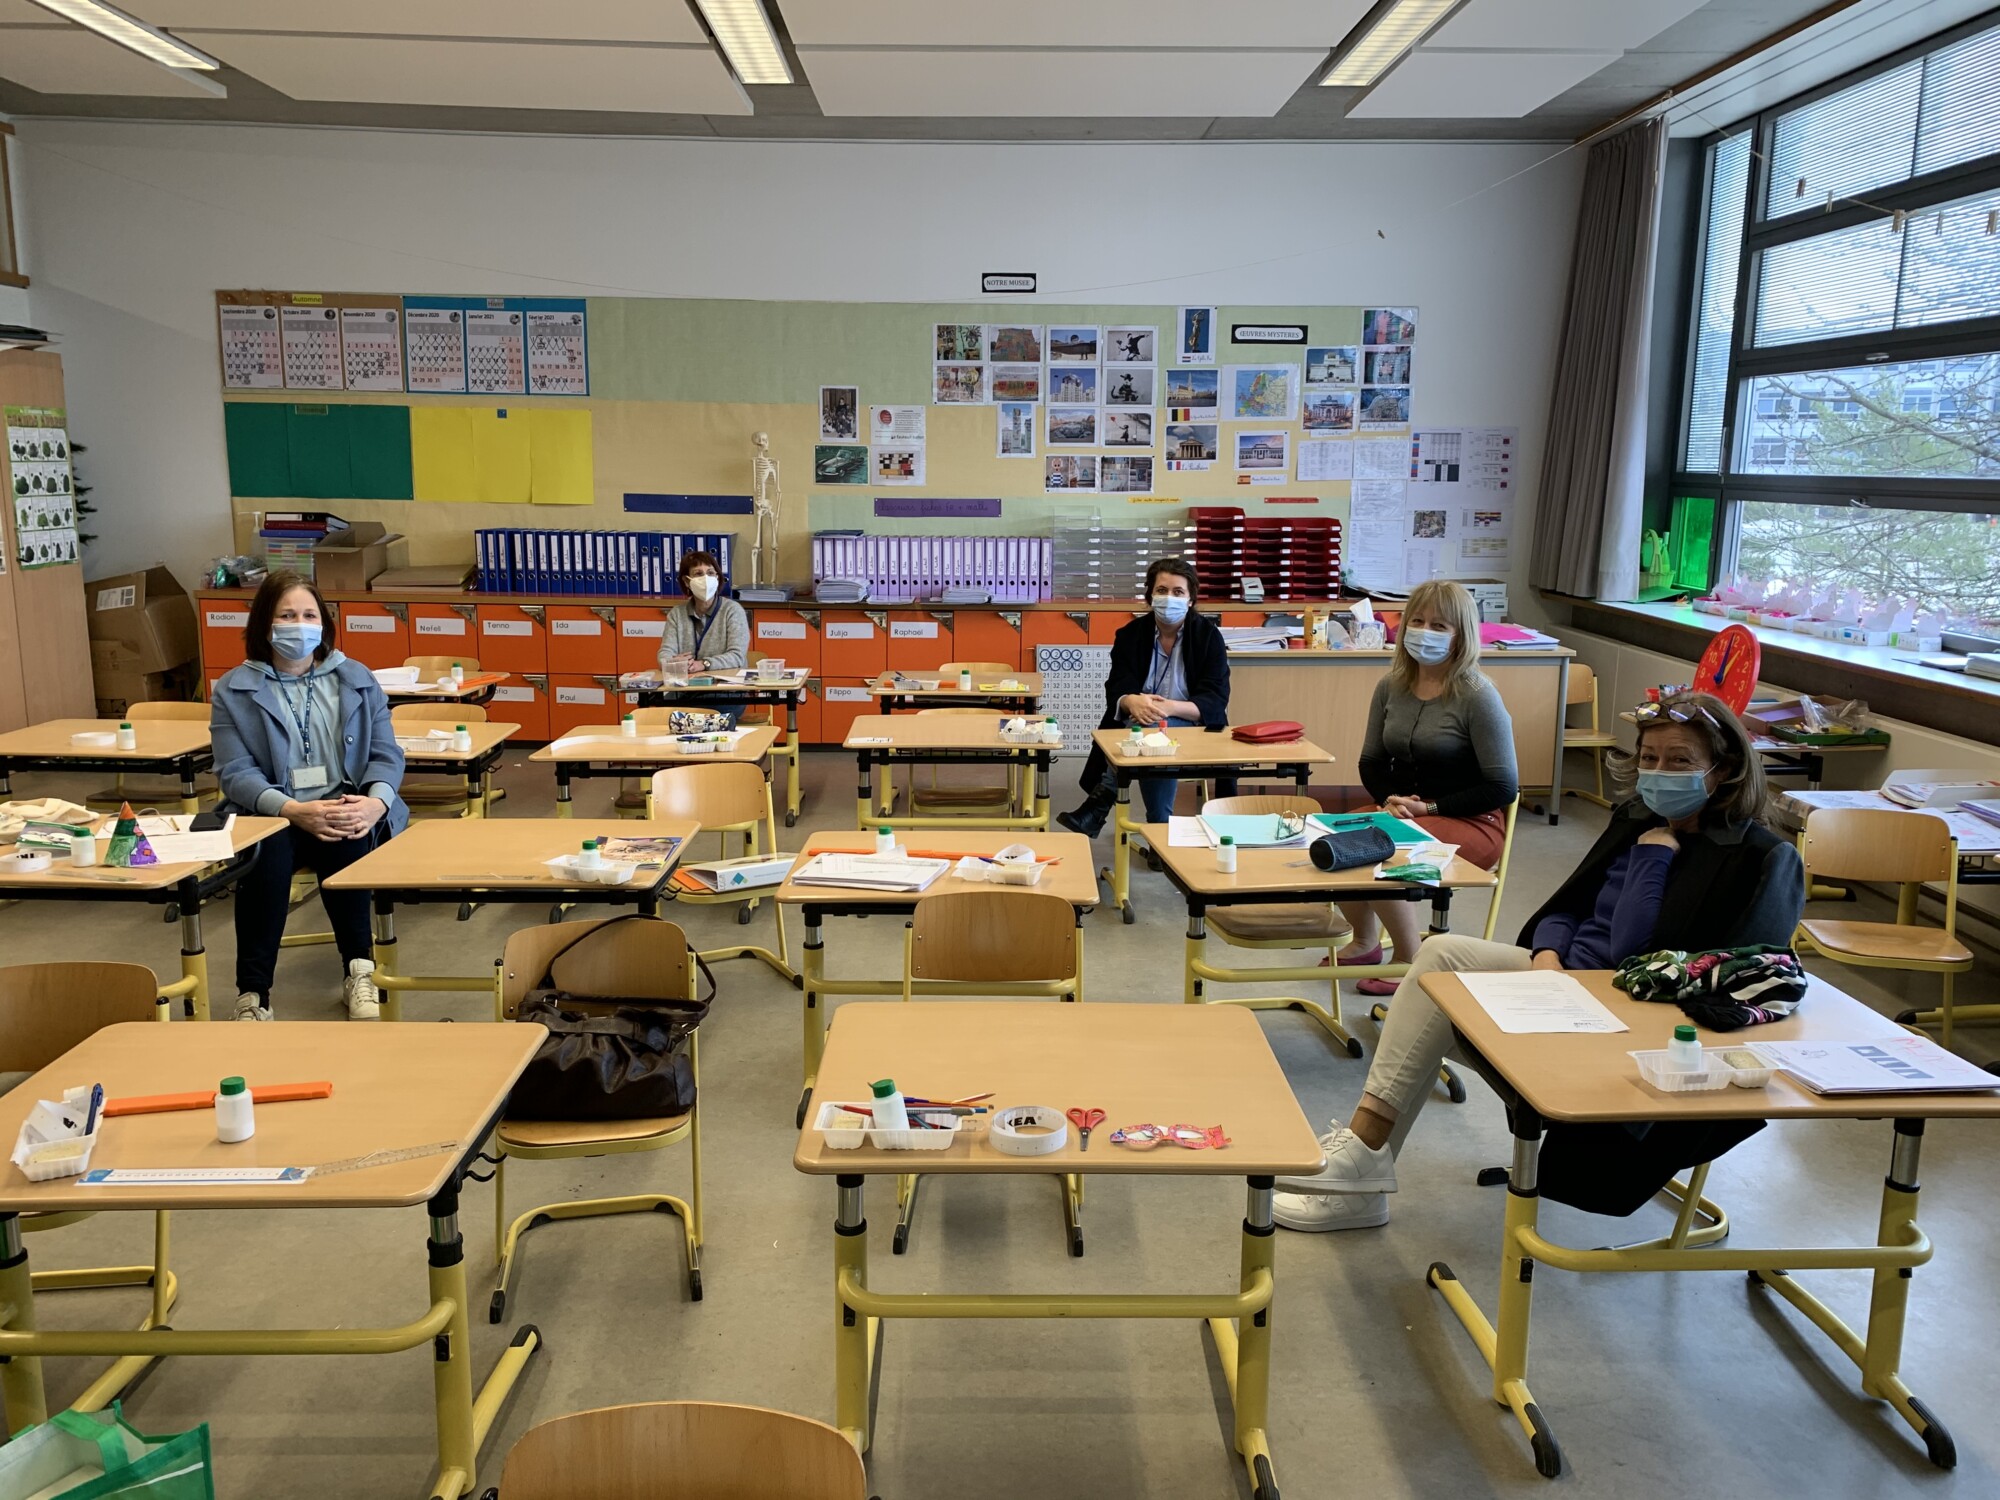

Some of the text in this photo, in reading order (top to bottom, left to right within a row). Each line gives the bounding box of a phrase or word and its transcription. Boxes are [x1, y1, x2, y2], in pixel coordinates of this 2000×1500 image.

[1700, 668, 1705, 678] 9
[1742, 662, 1748, 673] 2
[1739, 680, 1745, 692] 3
